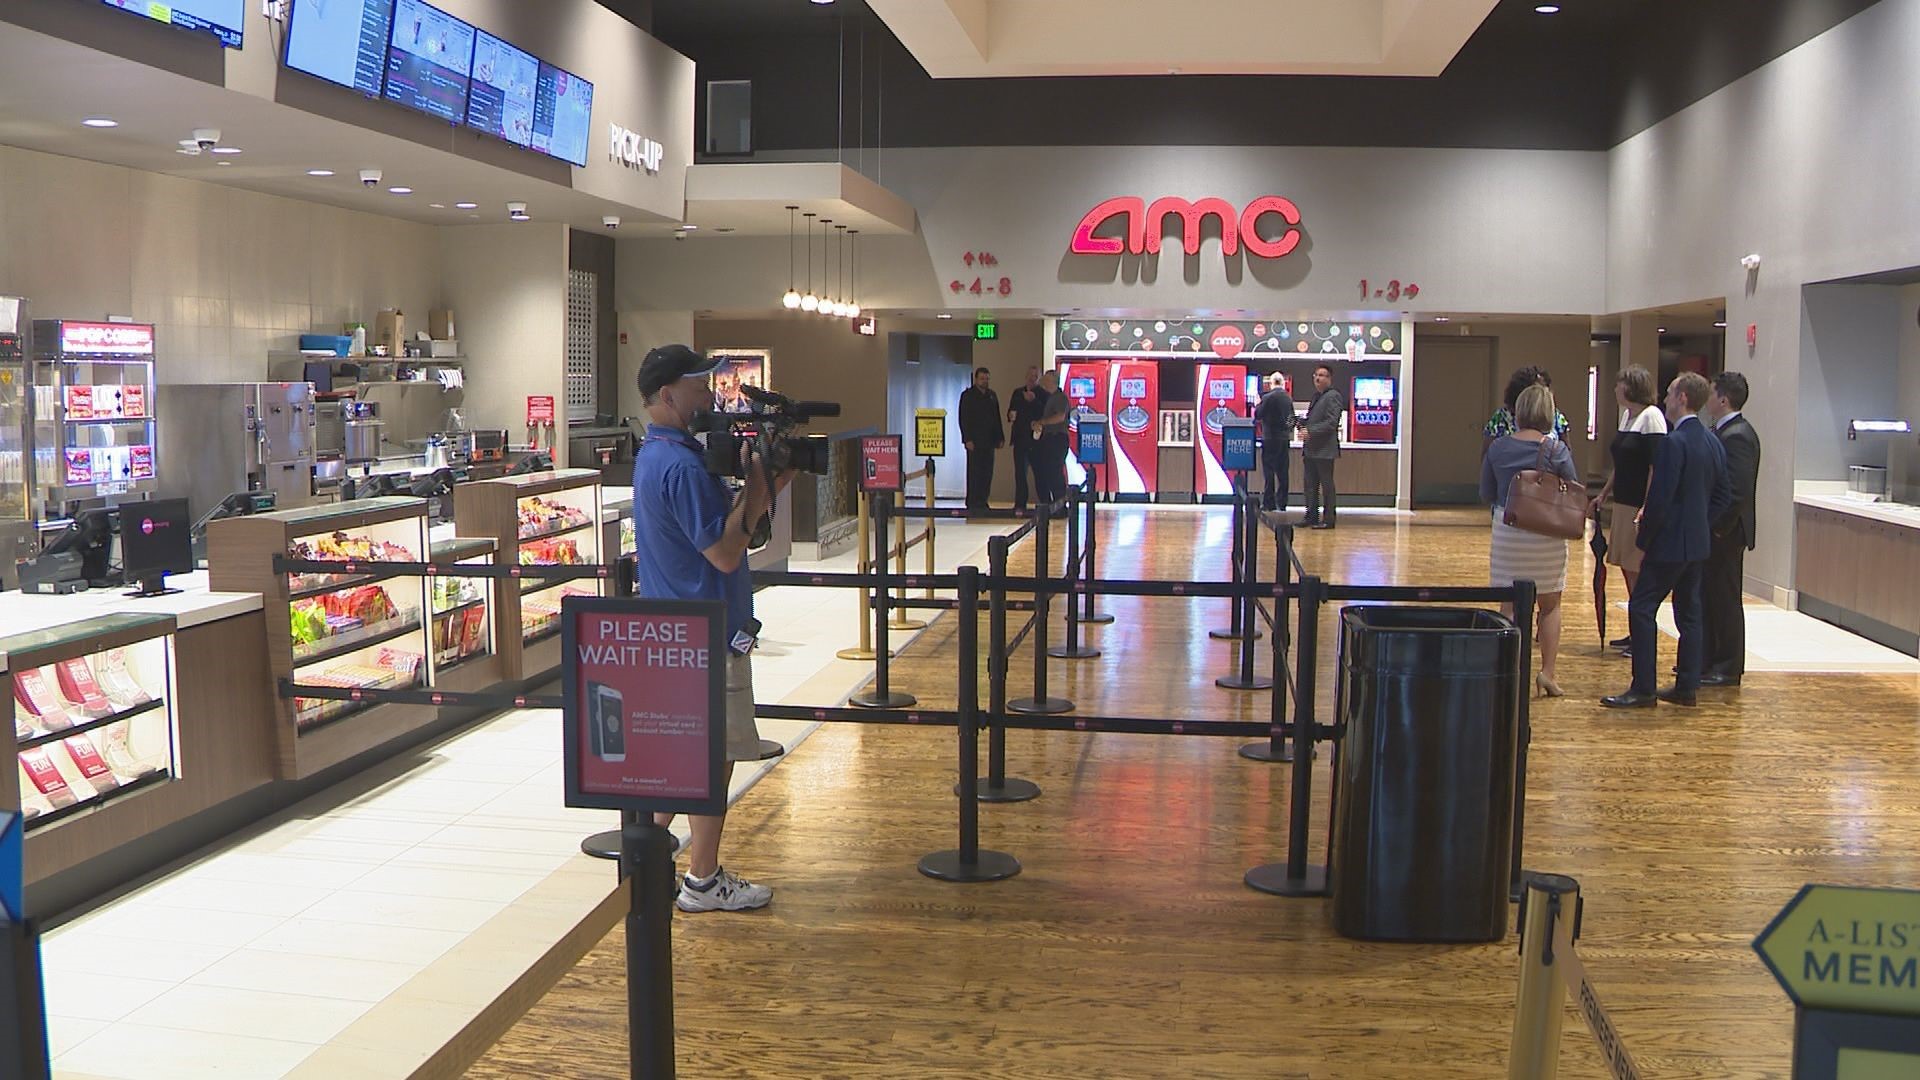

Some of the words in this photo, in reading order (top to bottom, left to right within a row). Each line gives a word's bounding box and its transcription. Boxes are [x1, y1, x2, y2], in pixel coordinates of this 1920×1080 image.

[608, 121, 664, 171] PICK-UP
[977, 324, 996, 338] EXIT
[1081, 440, 1103, 448] HERE
[1226, 446, 1251, 454] HERE
[600, 621, 688, 642] PLEASE
[578, 645, 640, 666] WAIT
[647, 648, 709, 668] HERE
[1803, 951, 1918, 988] MEM
